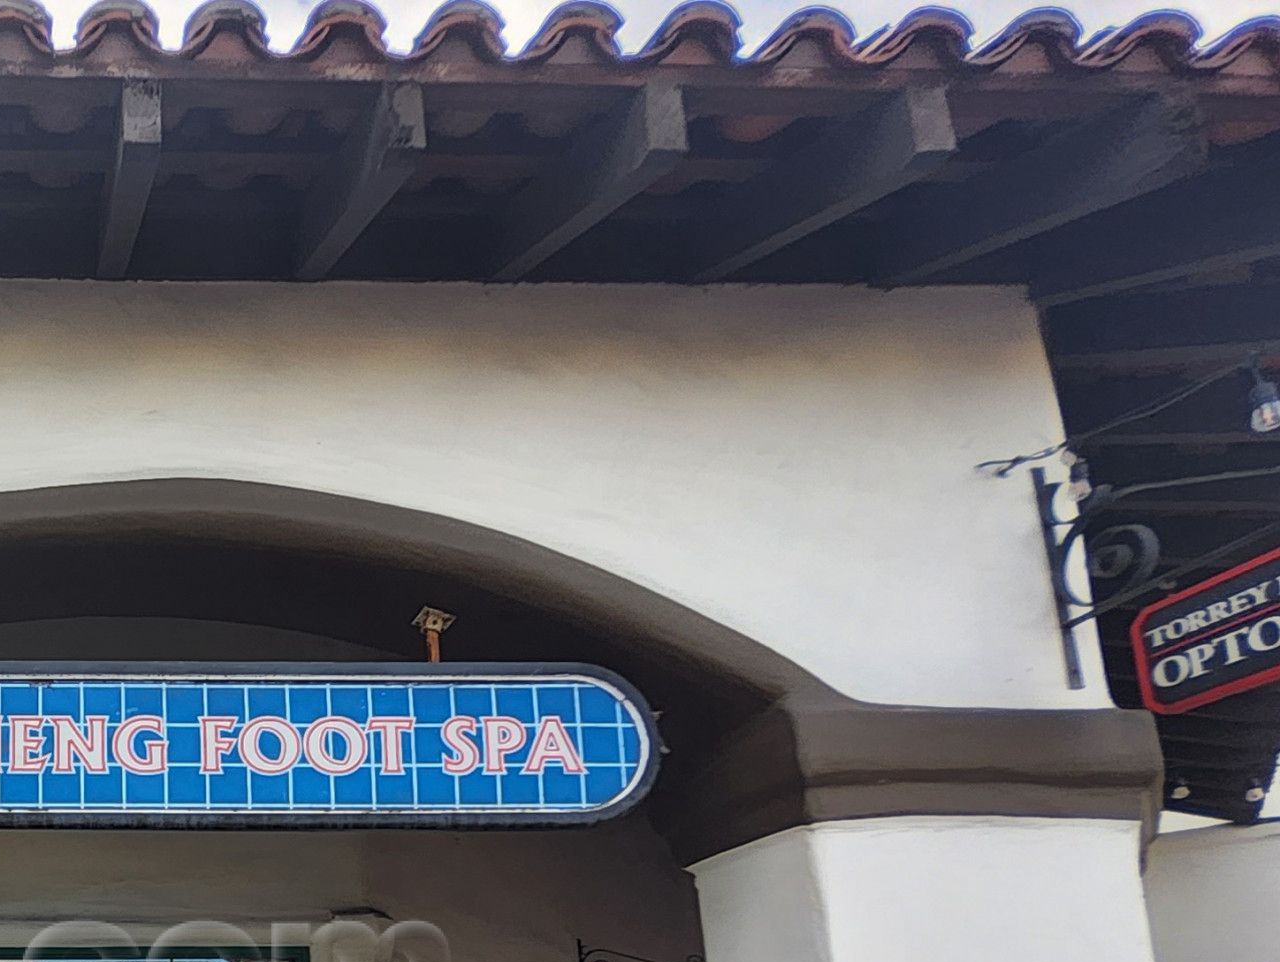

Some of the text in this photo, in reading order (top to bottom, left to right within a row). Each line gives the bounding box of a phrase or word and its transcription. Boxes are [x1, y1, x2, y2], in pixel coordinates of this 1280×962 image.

[1146, 580, 1274, 647] TORREY
[197, 714, 417, 776] FOOT
[440, 715, 589, 776] SPA
